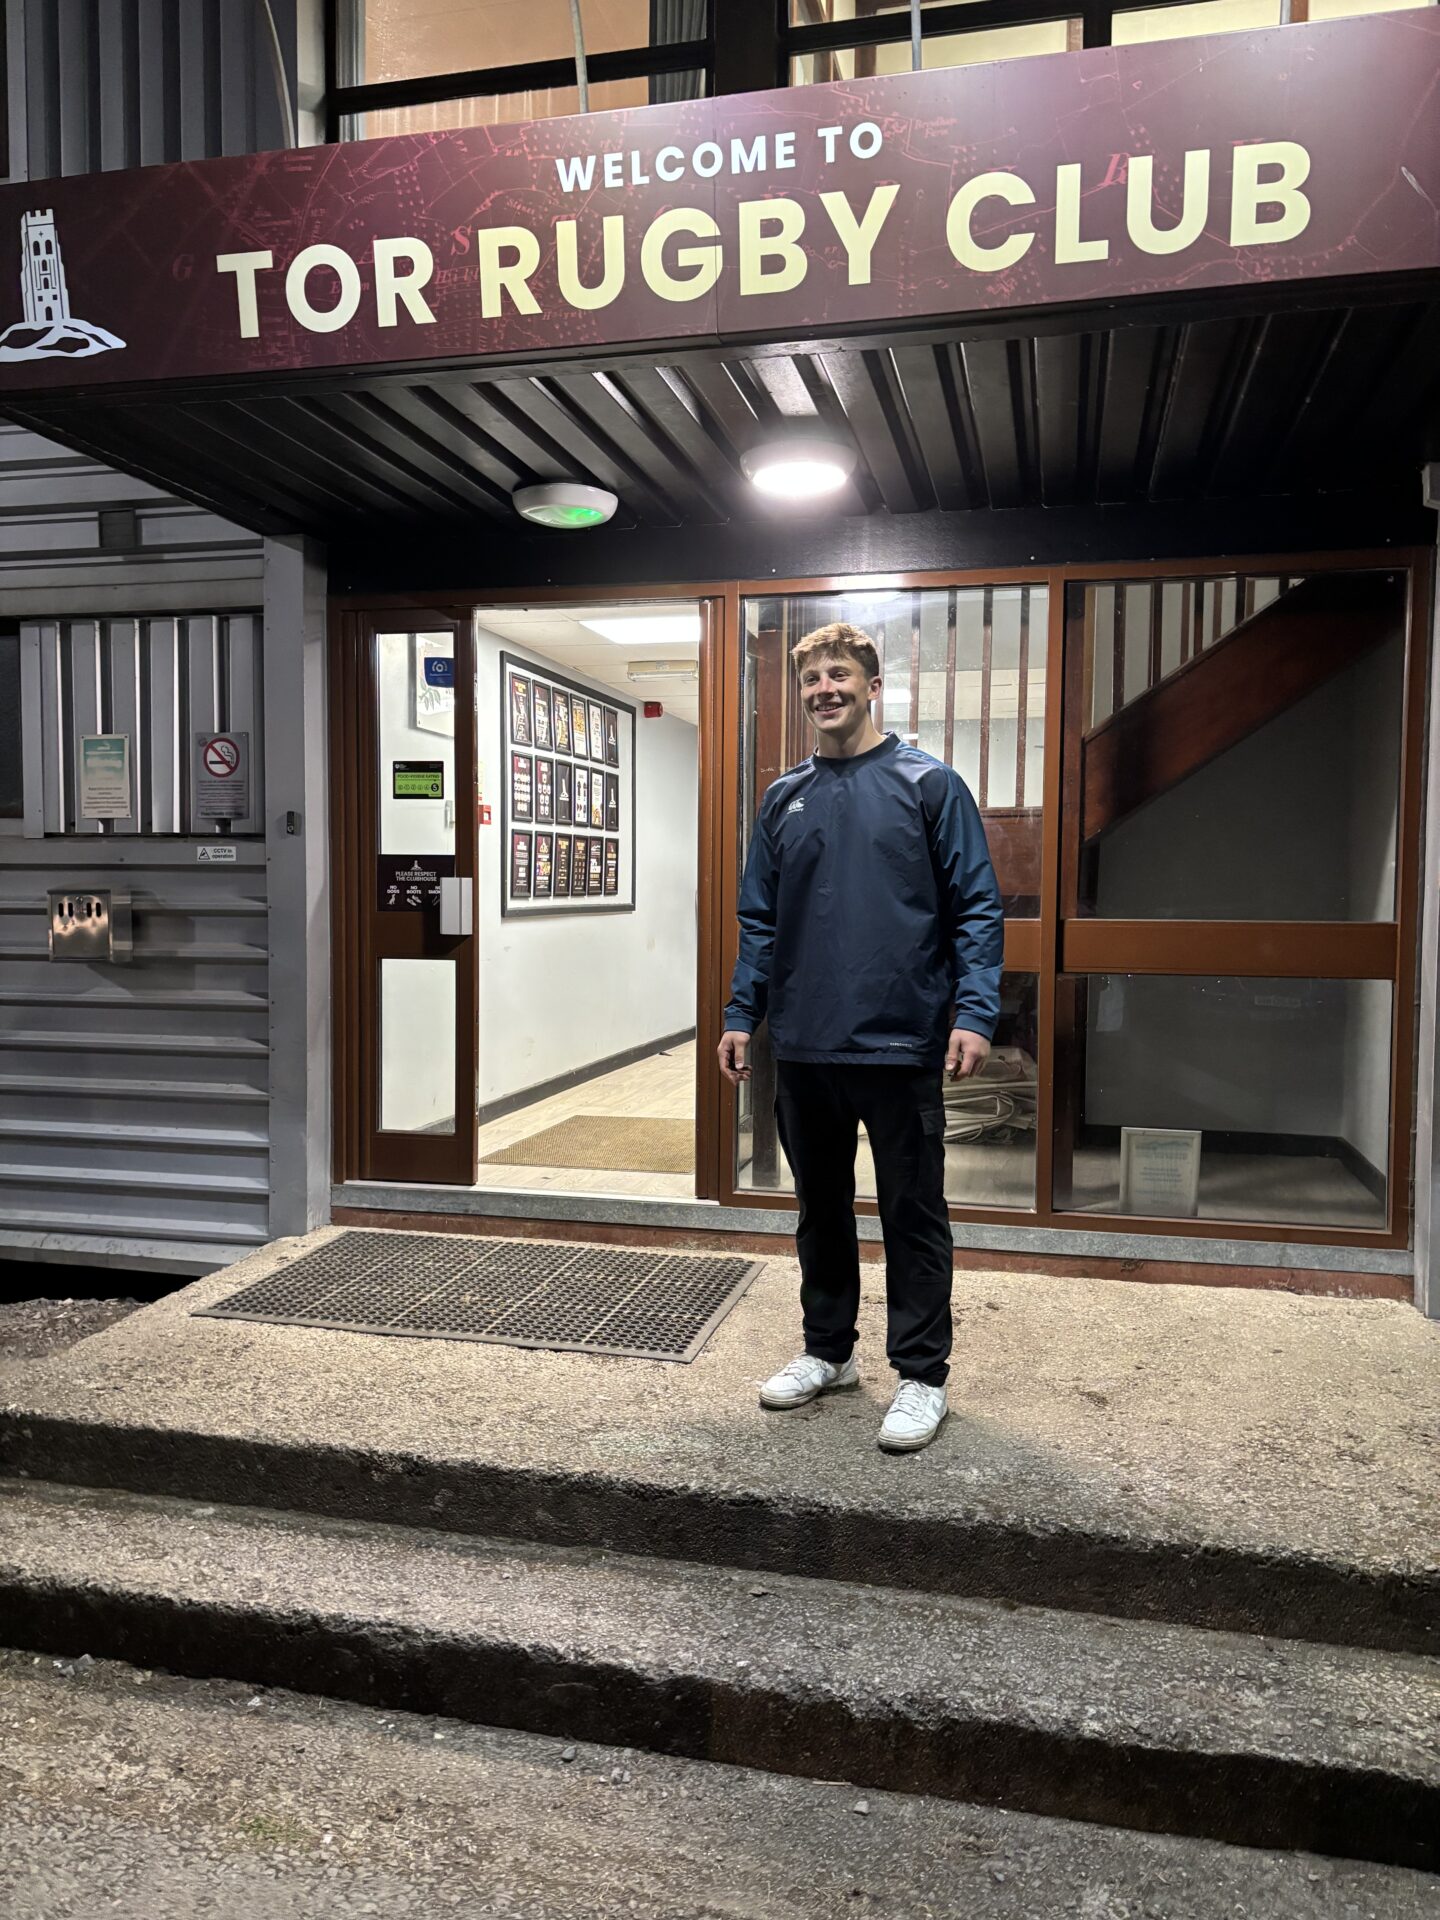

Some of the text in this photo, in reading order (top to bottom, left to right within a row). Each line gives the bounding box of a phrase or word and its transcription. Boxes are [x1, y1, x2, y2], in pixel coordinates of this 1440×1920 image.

[555, 122, 883, 193] WELCOME TO
[216, 141, 1312, 339] TOR RUGBY CLUB
